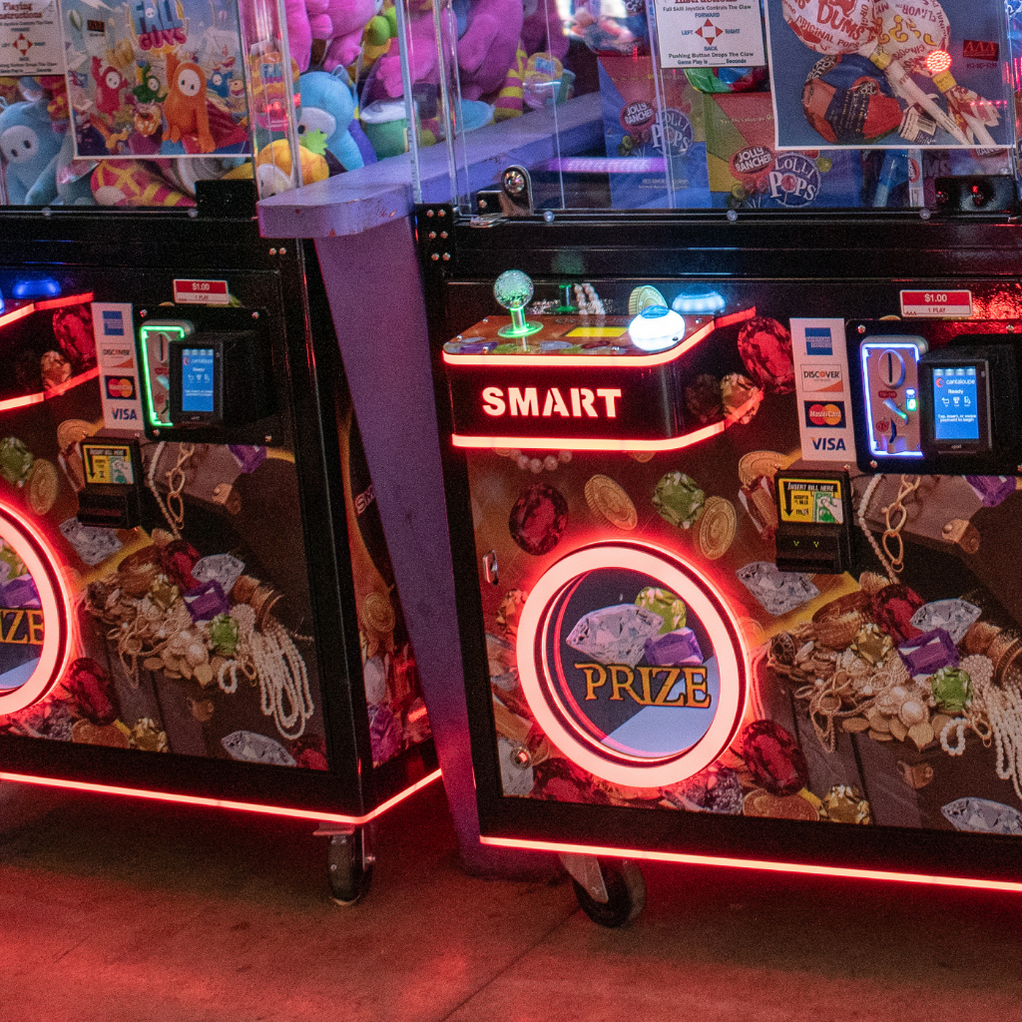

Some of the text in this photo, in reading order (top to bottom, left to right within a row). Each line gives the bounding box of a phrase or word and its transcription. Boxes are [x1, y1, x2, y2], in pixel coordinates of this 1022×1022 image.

[139, 27, 187, 51] GUYS
[627, 102, 647, 115] JOLLY
[624, 109, 653, 126] RANCHER
[738, 147, 765, 162] JOLLY
[734, 153, 773, 173] RANCHER
[768, 171, 816, 200] POPS
[192, 283, 210, 291] $1.00
[924, 294, 947, 303] $1.00
[103, 348, 130, 356] DISCOVER
[803, 370, 840, 379] DISCOVER
[482, 387, 622, 418] SMART
[112, 408, 137, 420] VISA
[809, 410, 841, 418] MasterCard
[811, 437, 846, 451] VISA
[788, 482, 807, 490] INSERT
[573, 661, 712, 709] PRIZE
